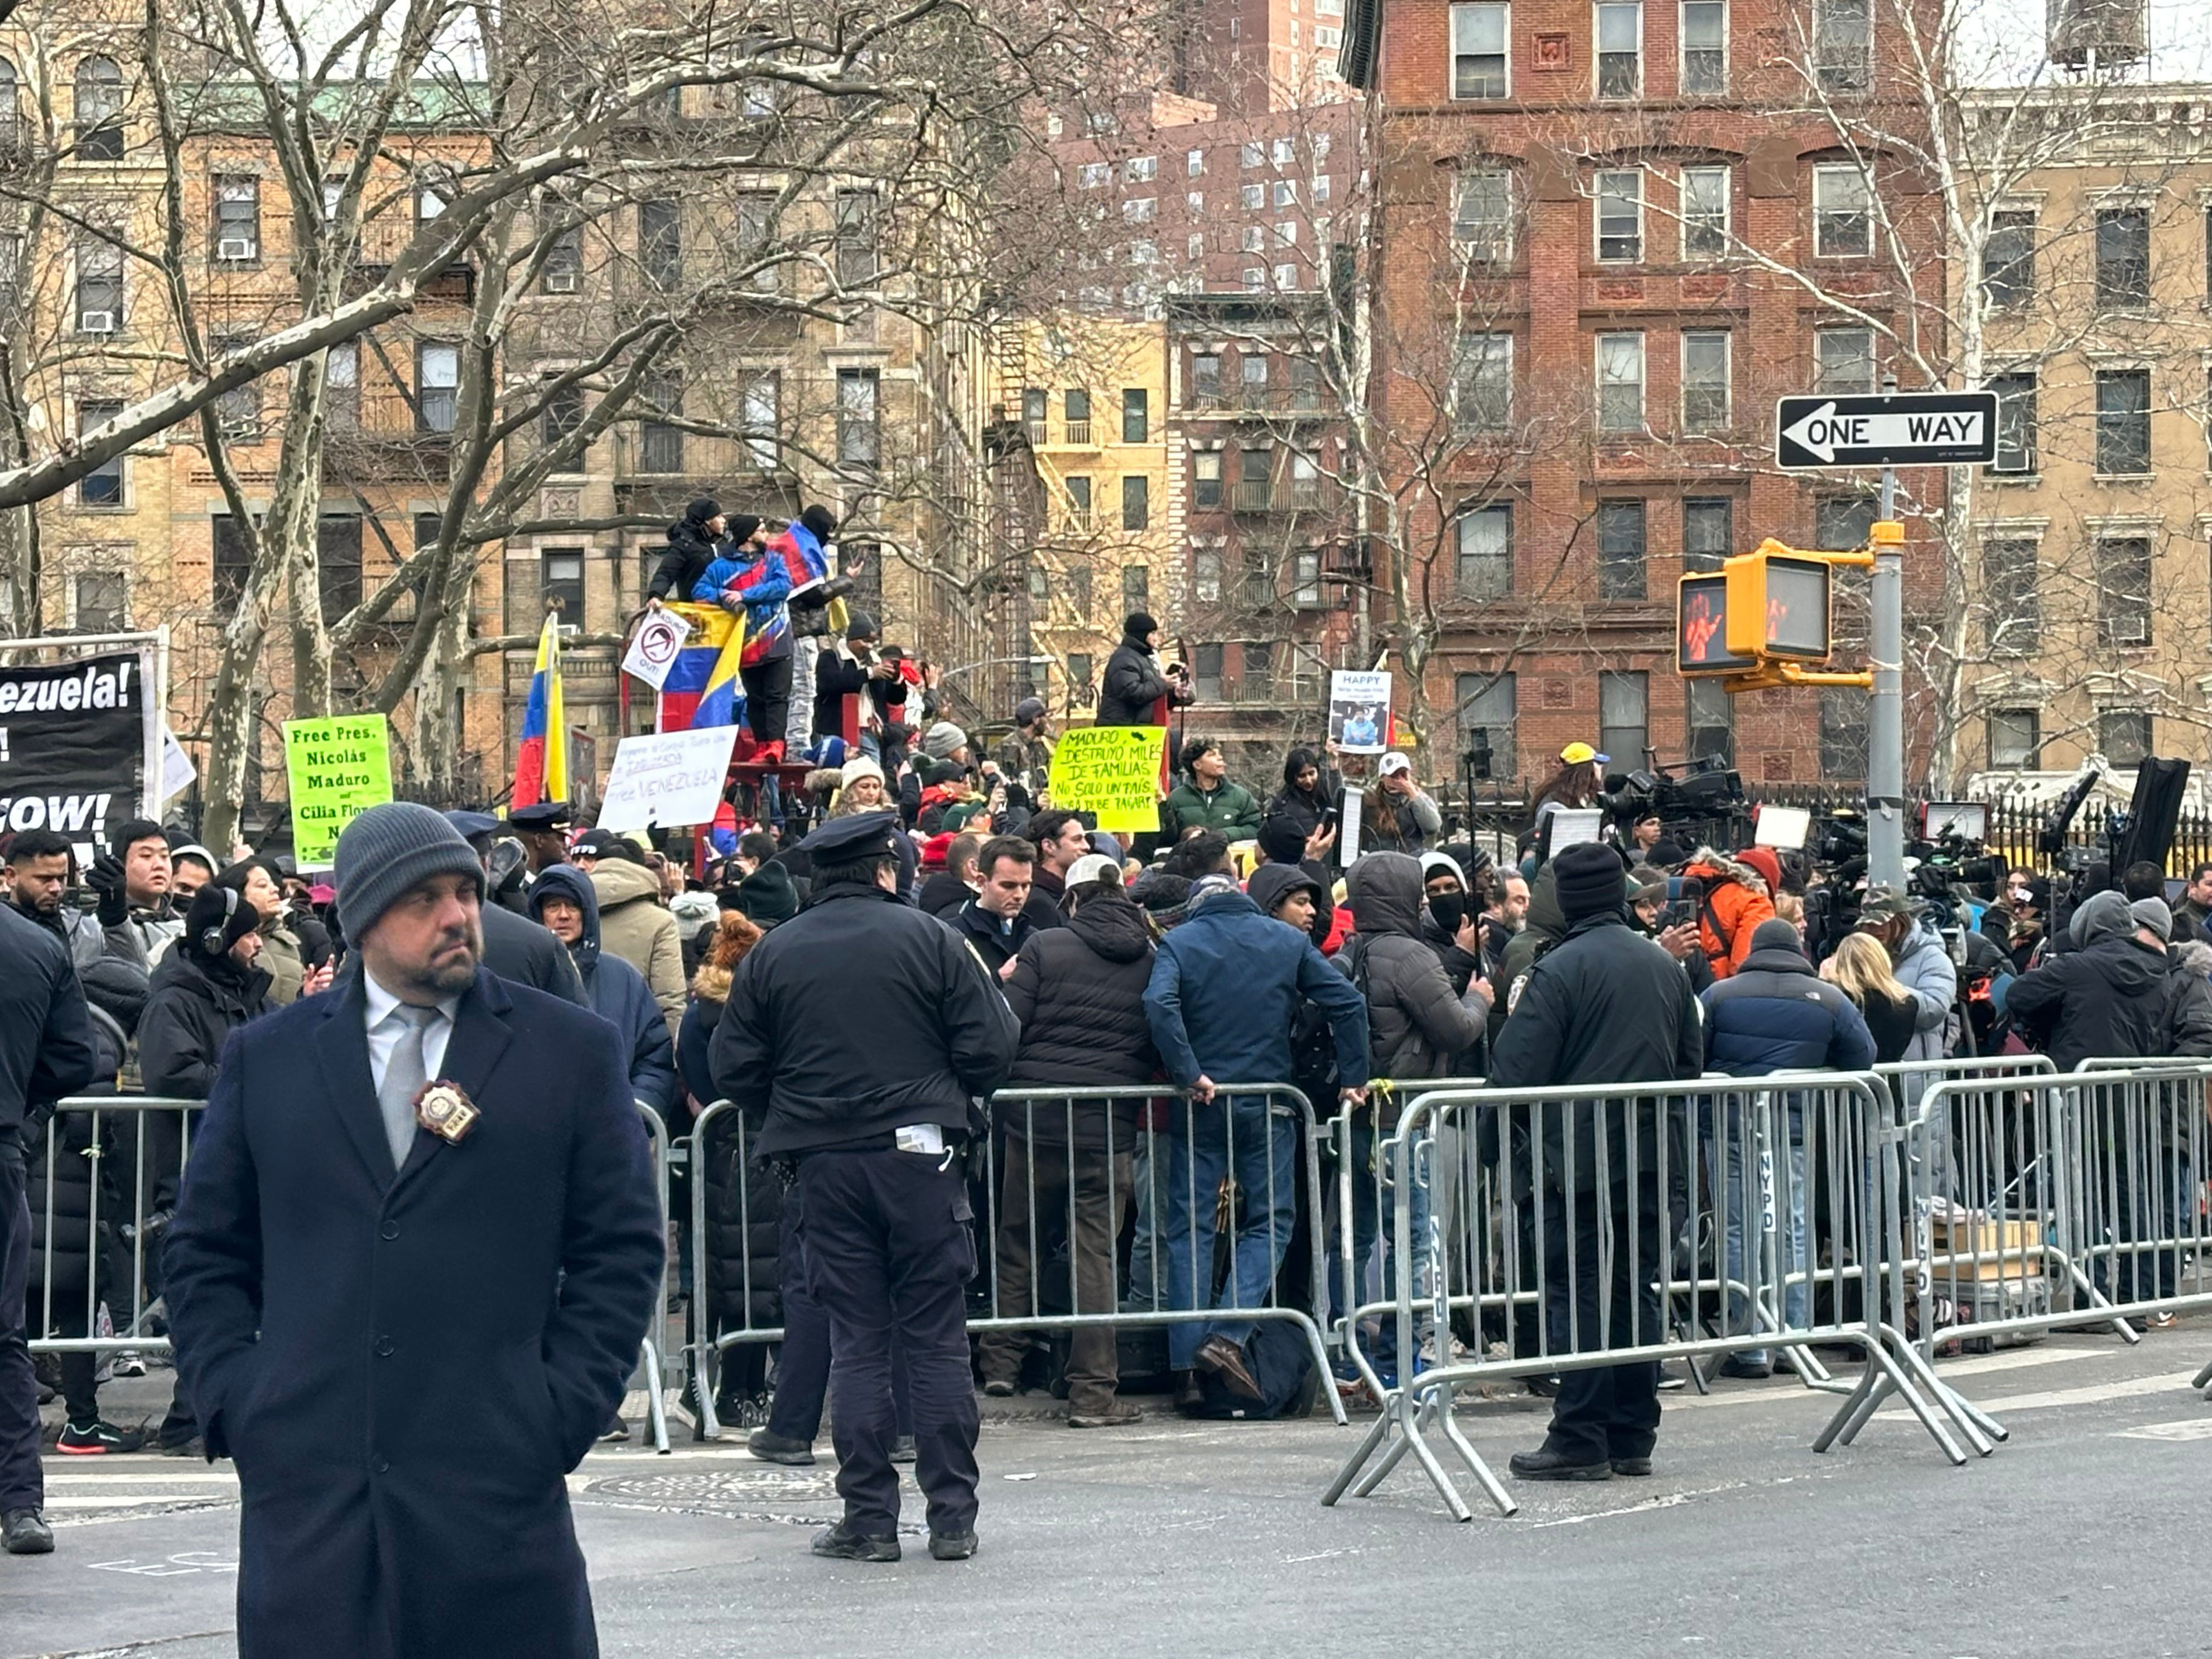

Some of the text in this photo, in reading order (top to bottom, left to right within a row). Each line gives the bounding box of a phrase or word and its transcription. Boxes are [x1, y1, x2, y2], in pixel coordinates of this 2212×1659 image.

[1808, 415, 1976, 445] ONE WAY
[657, 613, 685, 634] ADURO
[1343, 675, 1380, 685] HAPPY
[292, 727, 377, 744] Free Pres.
[1066, 730, 1119, 746] MADURO
[1130, 744, 1162, 761] MILES
[1068, 761, 1151, 780] DE FAMILIAS
[307, 773, 370, 789] Maduro
[1107, 782, 1121, 795] UN
[300, 805, 336, 819] Cilia
[1761, 1155, 1773, 1228] NYPD
